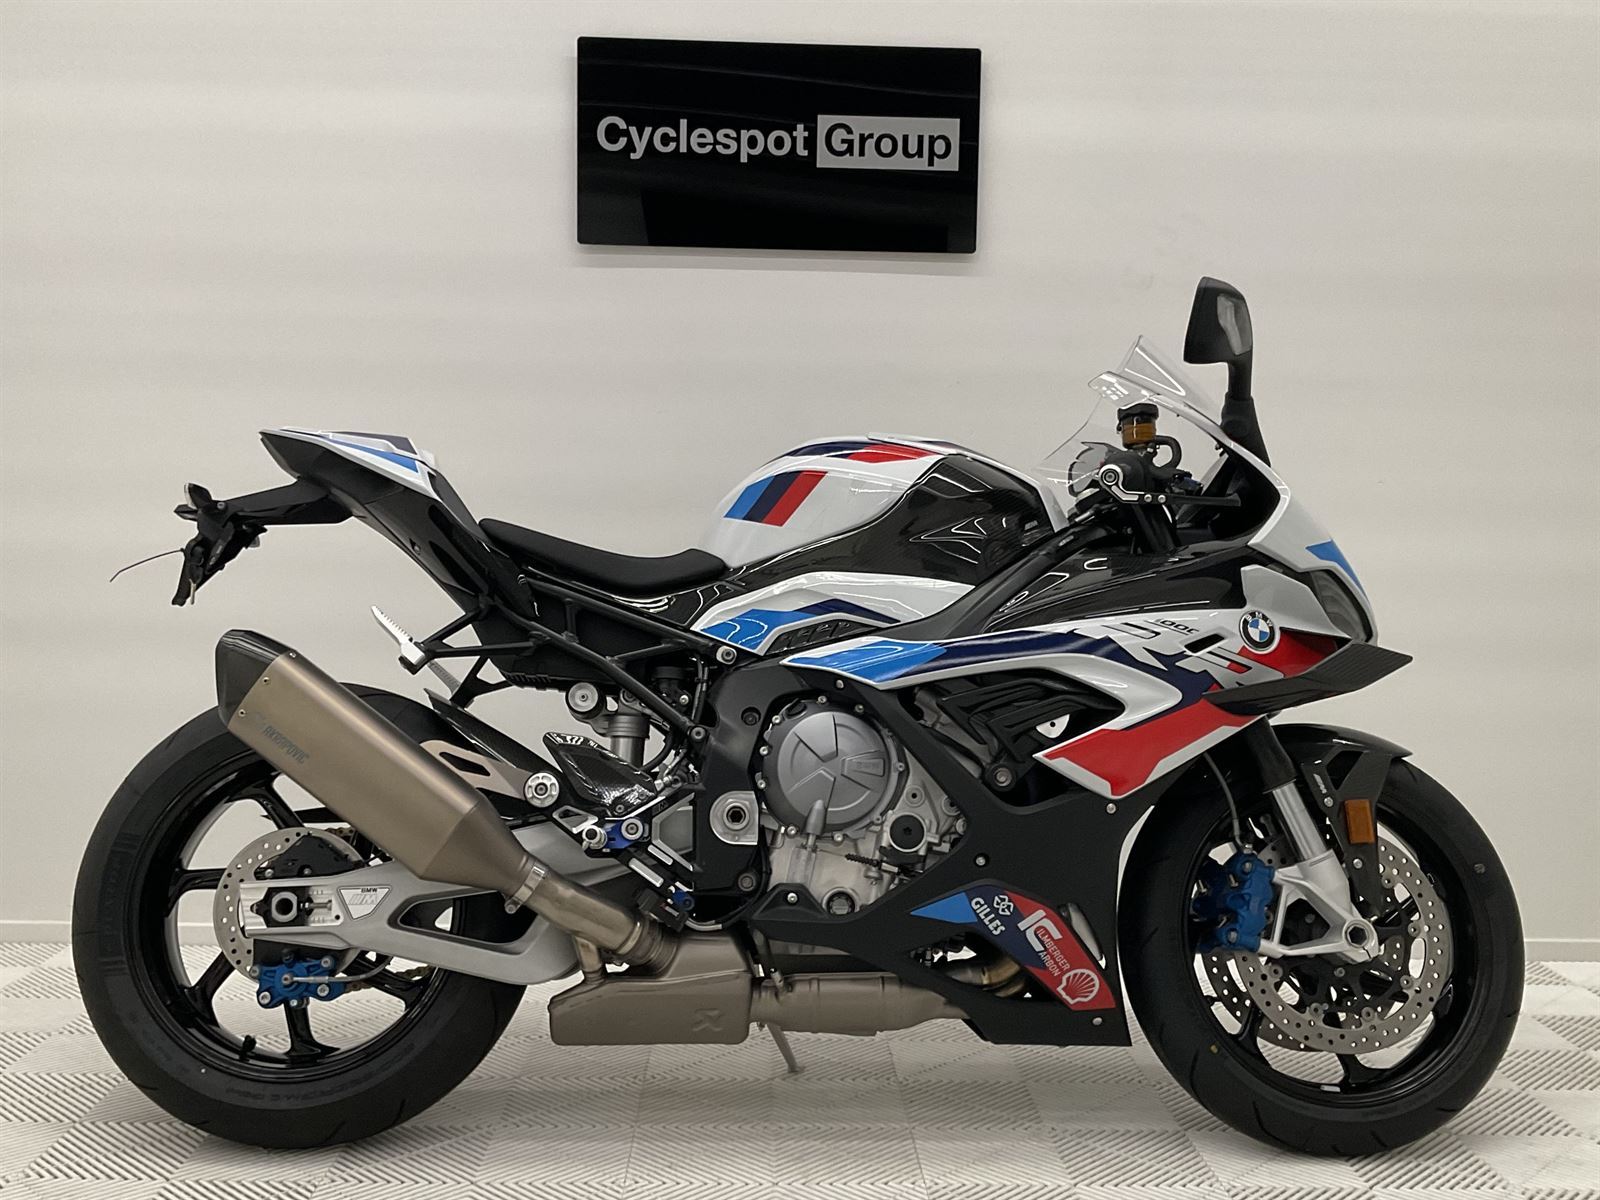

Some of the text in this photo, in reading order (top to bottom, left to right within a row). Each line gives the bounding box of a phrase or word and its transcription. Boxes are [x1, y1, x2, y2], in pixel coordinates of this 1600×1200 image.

[596, 116, 953, 167] Cyclespot Group
[970, 897, 1006, 936] GILLES
